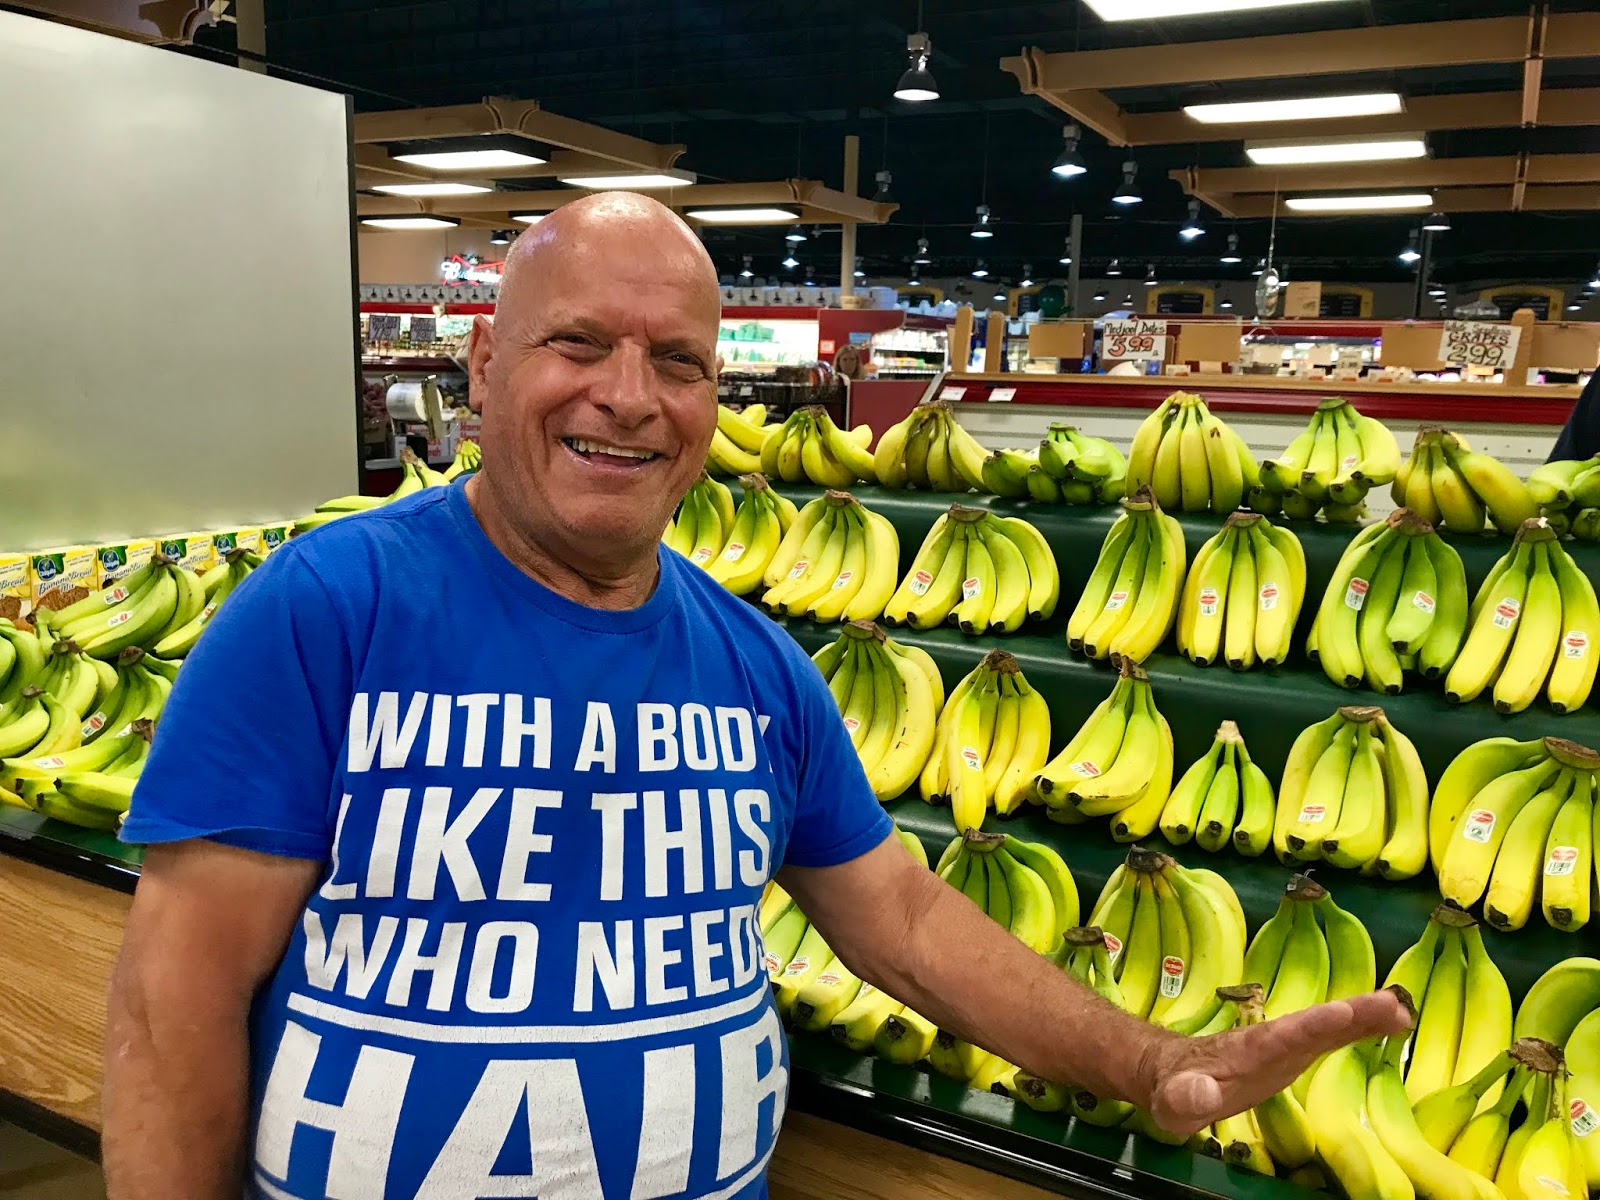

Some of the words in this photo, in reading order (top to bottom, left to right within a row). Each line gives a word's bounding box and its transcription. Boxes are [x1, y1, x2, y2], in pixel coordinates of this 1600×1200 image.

[1139, 321, 1165, 335] Dates
[39, 577, 70, 596] Banana
[347, 691, 551, 772] WITH
[574, 701, 616, 773] A
[319, 786, 563, 902] LIKE
[304, 907, 539, 1013] WHO
[255, 1006, 788, 1200] HAIR
